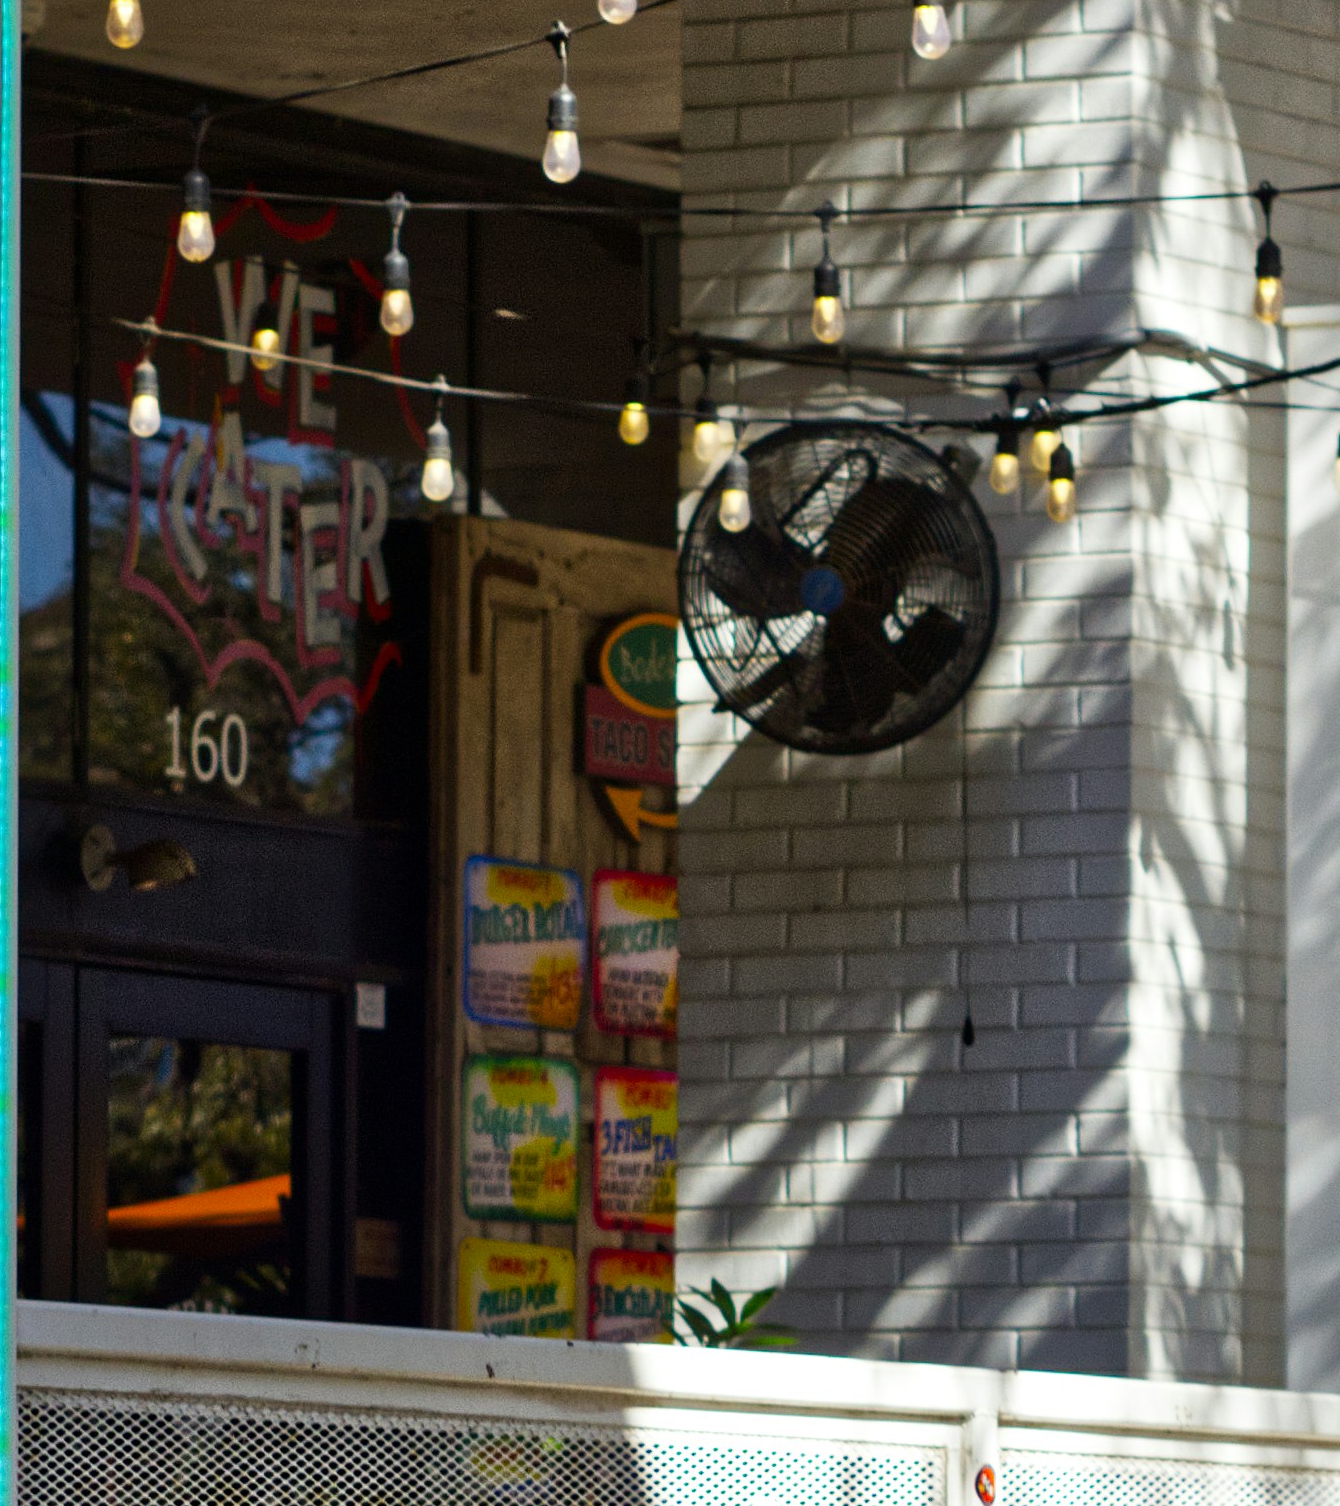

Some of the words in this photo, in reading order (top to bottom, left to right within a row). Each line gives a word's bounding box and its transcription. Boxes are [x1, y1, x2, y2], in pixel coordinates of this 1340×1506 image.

[213, 255, 338, 431] WE
[164, 704, 249, 786] 160
[590, 717, 649, 766] TACO
